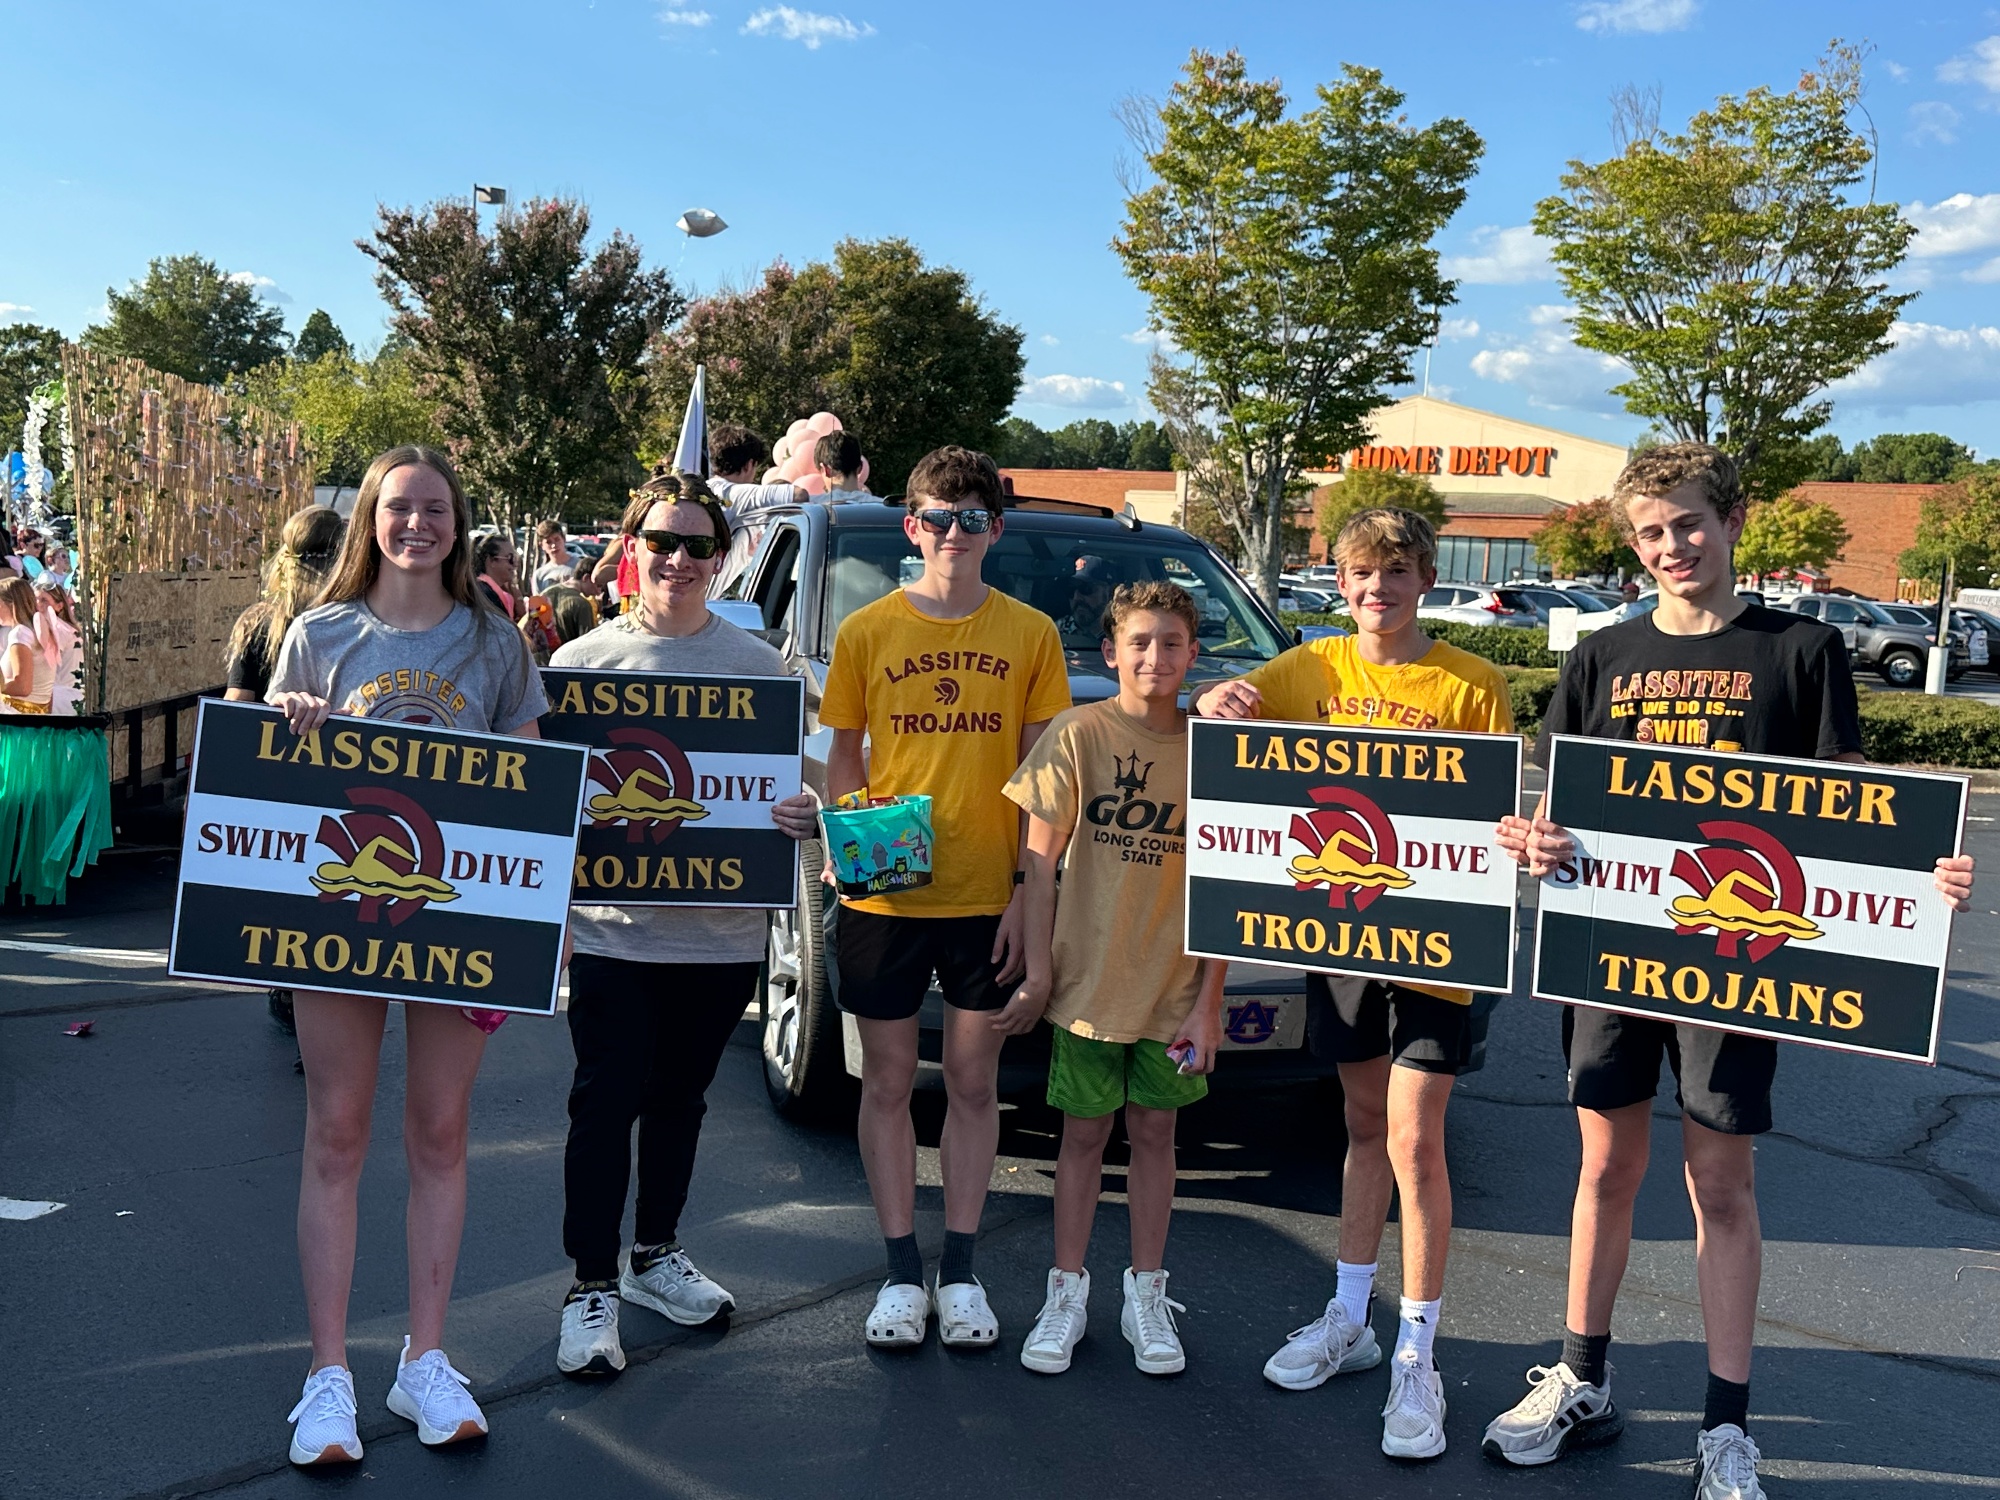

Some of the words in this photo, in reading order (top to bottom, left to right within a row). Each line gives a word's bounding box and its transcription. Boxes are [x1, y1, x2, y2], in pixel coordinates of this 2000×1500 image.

[1351, 445, 1438, 475] HOME
[1447, 446, 1552, 476] DEPOT
[884, 651, 1011, 684] LASSITER
[1611, 670, 1753, 702] LASSITER
[349, 669, 466, 717] LASSITER
[557, 681, 757, 720] ASSITER
[1316, 695, 1439, 729] LASSITER
[1611, 703, 1637, 719] ALL
[1642, 701, 1669, 715] WE
[1675, 700, 1700, 715] DO
[1705, 701, 1745, 717] IS...
[890, 712, 1002, 734] TROJANS
[256, 720, 527, 791] LASSITER
[1234, 733, 1467, 784] LASSITER
[699, 775, 777, 802] DIVE
[1608, 755, 1898, 829] LASSITER
[1086, 794, 1185, 837] GOL
[197, 822, 309, 864] SWIM
[1094, 829, 1134, 847] LONG
[1140, 837, 1186, 854] COURS
[1121, 850, 1163, 866] STATE
[1197, 823, 1282, 857] SWIM
[1403, 841, 1489, 875] DIVE
[449, 849, 543, 889] DIVE
[574, 855, 744, 890] ROJANS
[1555, 856, 1663, 896] SWIM
[1811, 886, 1917, 930] DIVE
[240, 925, 493, 989] TROJANS
[1236, 909, 1453, 968] TROJANS
[1599, 951, 1865, 1030] TROJANS
